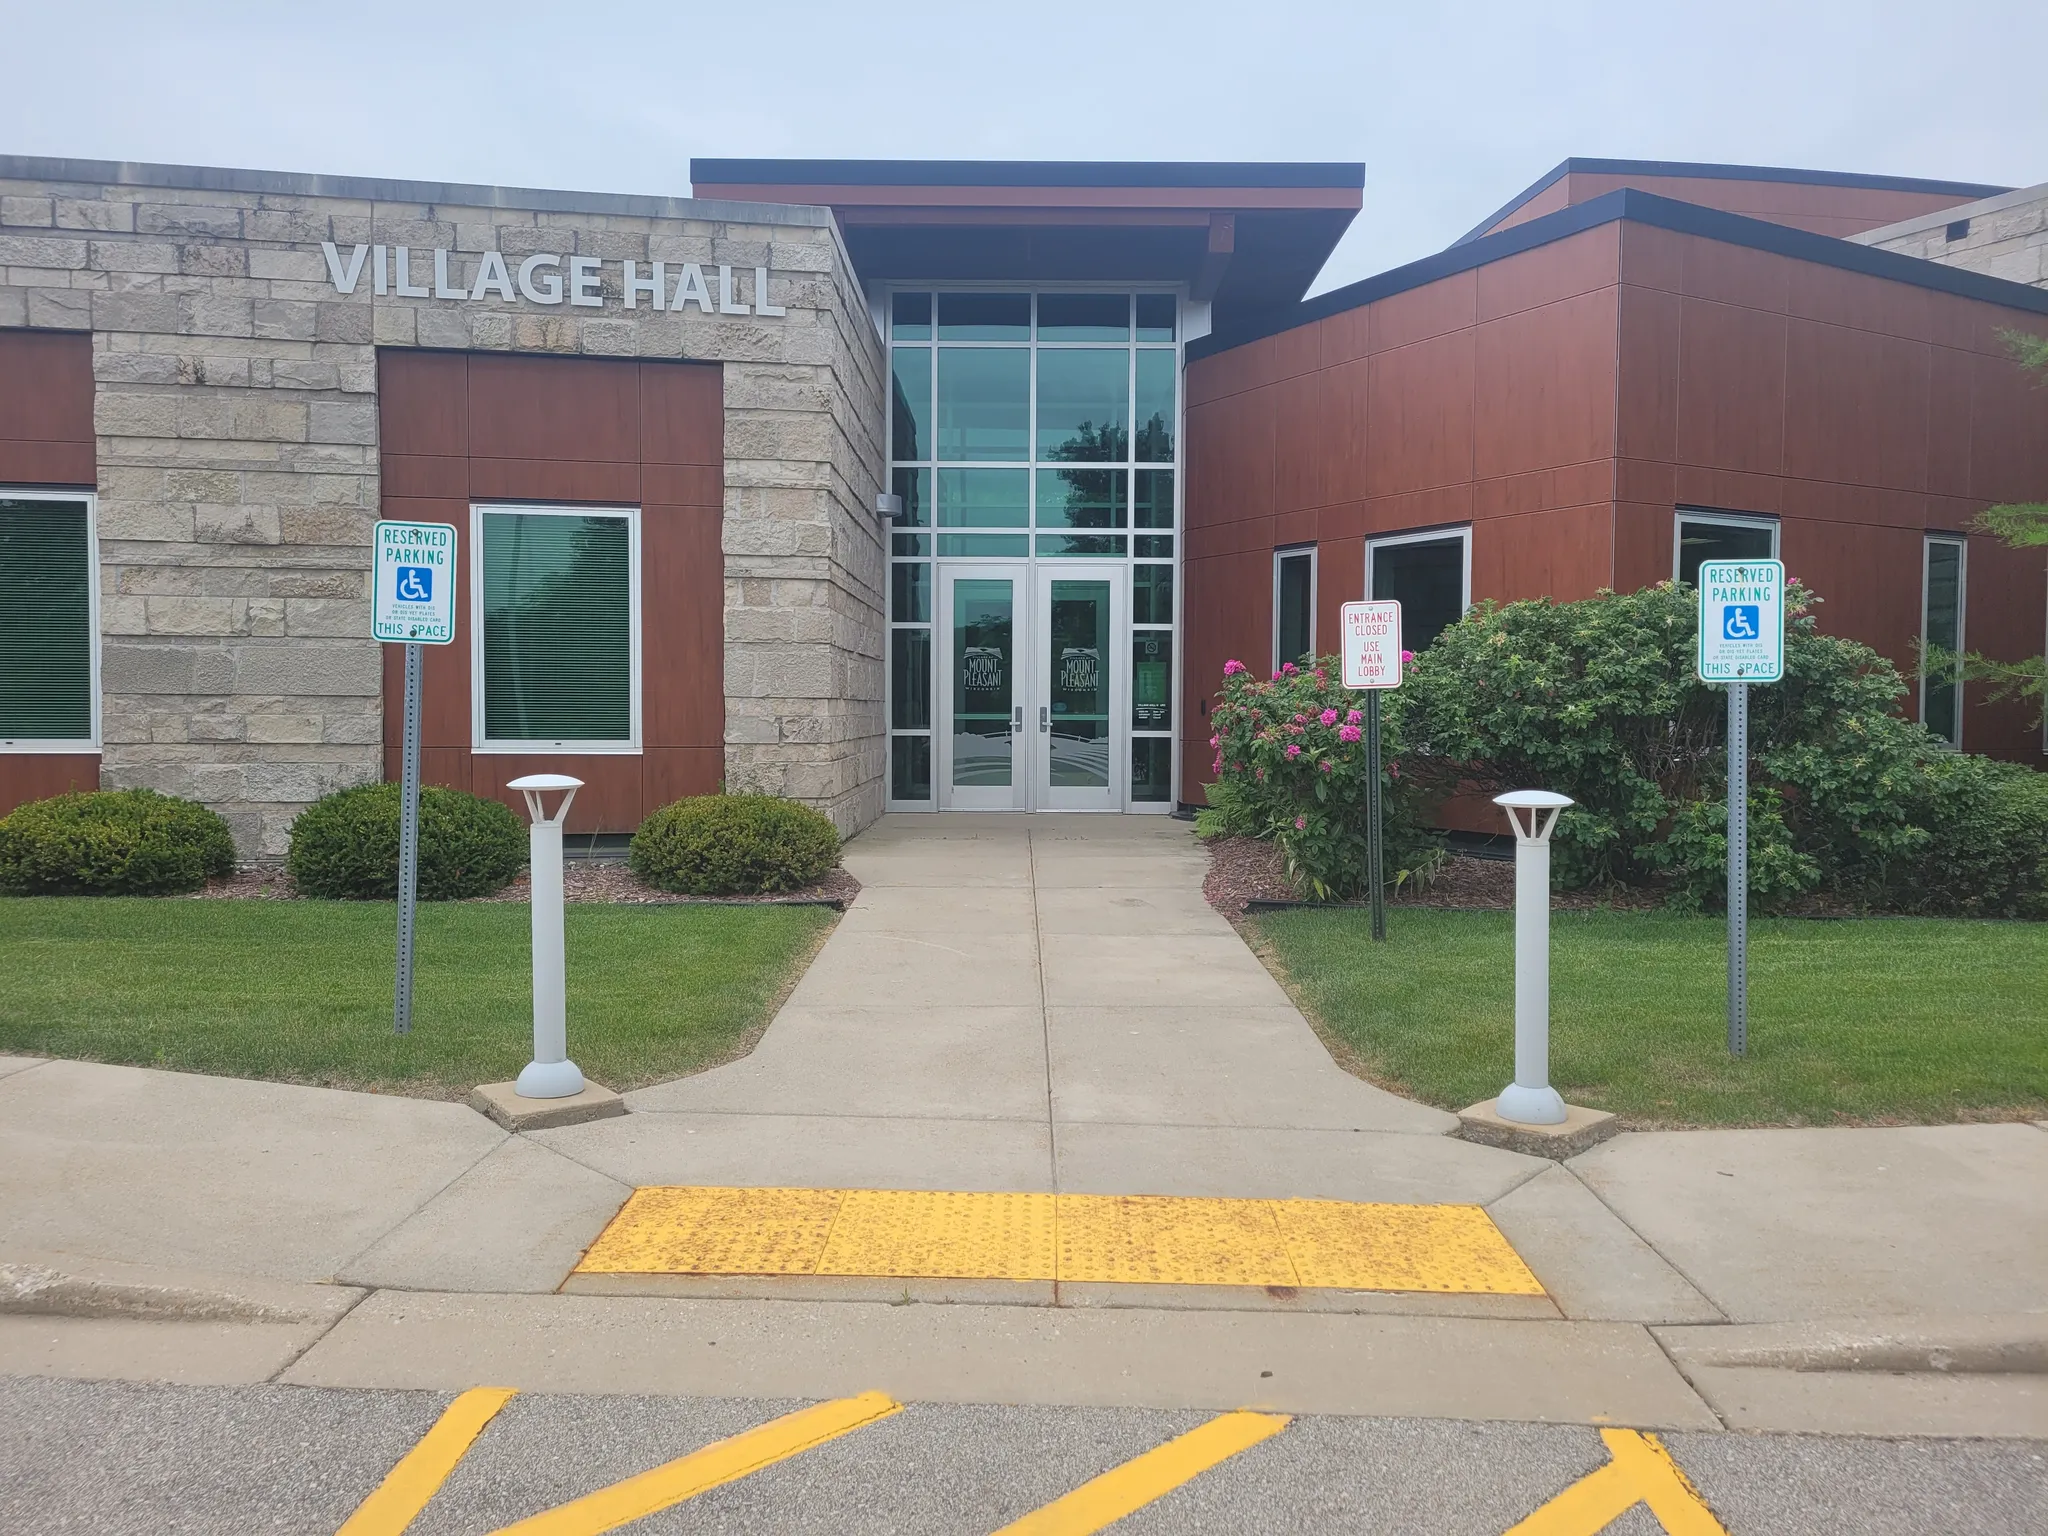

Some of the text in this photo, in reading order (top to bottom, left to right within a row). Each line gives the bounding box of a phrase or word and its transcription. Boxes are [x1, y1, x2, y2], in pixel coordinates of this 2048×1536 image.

[320, 241, 787, 317] VILLAGE HALL
[384, 528, 447, 547] RESERVED
[386, 547, 444, 565] PARKING
[1710, 568, 1773, 583] RESERVED
[1712, 586, 1771, 602] PARKING
[1348, 612, 1393, 624] ENTRANCE
[378, 622, 447, 637] THIS SPACE
[1355, 624, 1388, 636] CLOSED
[1364, 641, 1380, 652] USE
[968, 658, 998, 673] MOUNT
[1361, 654, 1382, 664] MAIN
[1066, 660, 1096, 674] MOUNT
[1358, 666, 1386, 676] LOBBY
[1706, 662, 1775, 674] THIS SPACE
[963, 670, 1002, 686] PLEASANT
[1060, 670, 1100, 688] PLEASANT
